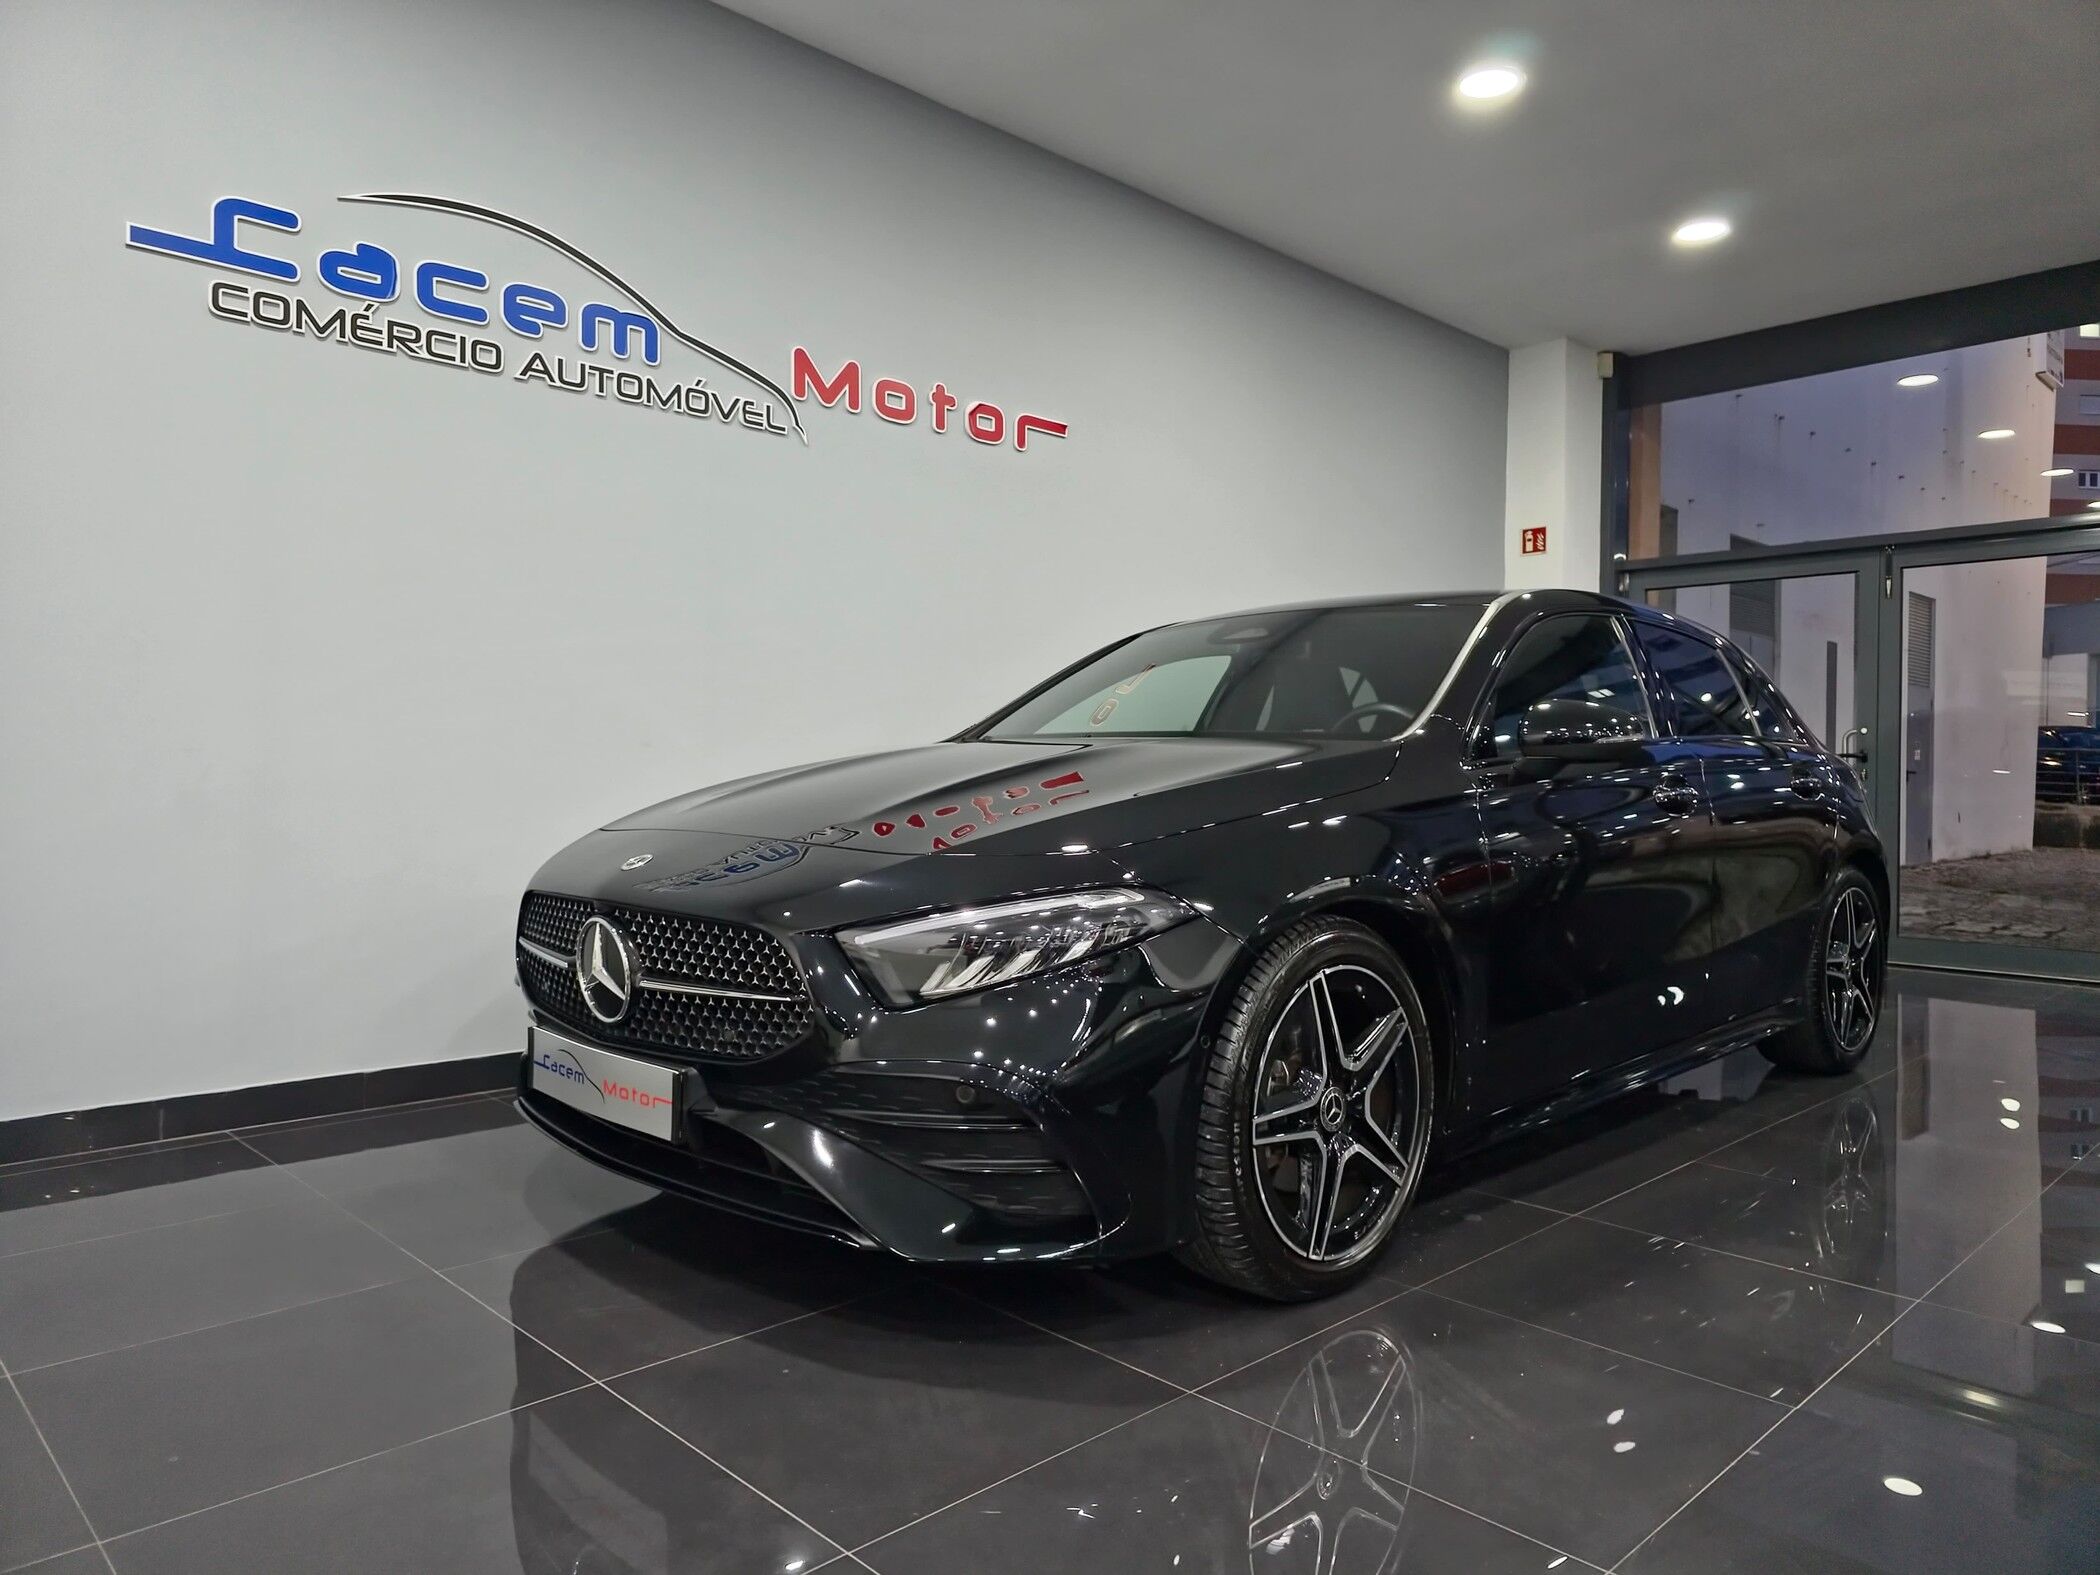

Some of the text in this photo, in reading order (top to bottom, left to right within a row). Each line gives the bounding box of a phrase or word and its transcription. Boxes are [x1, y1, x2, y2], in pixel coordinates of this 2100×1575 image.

[209, 281, 788, 436] COMÉRCIO AUTOMÓVEL
[791, 346, 1068, 452] Motor
[603, 1079, 672, 1108] Motor
